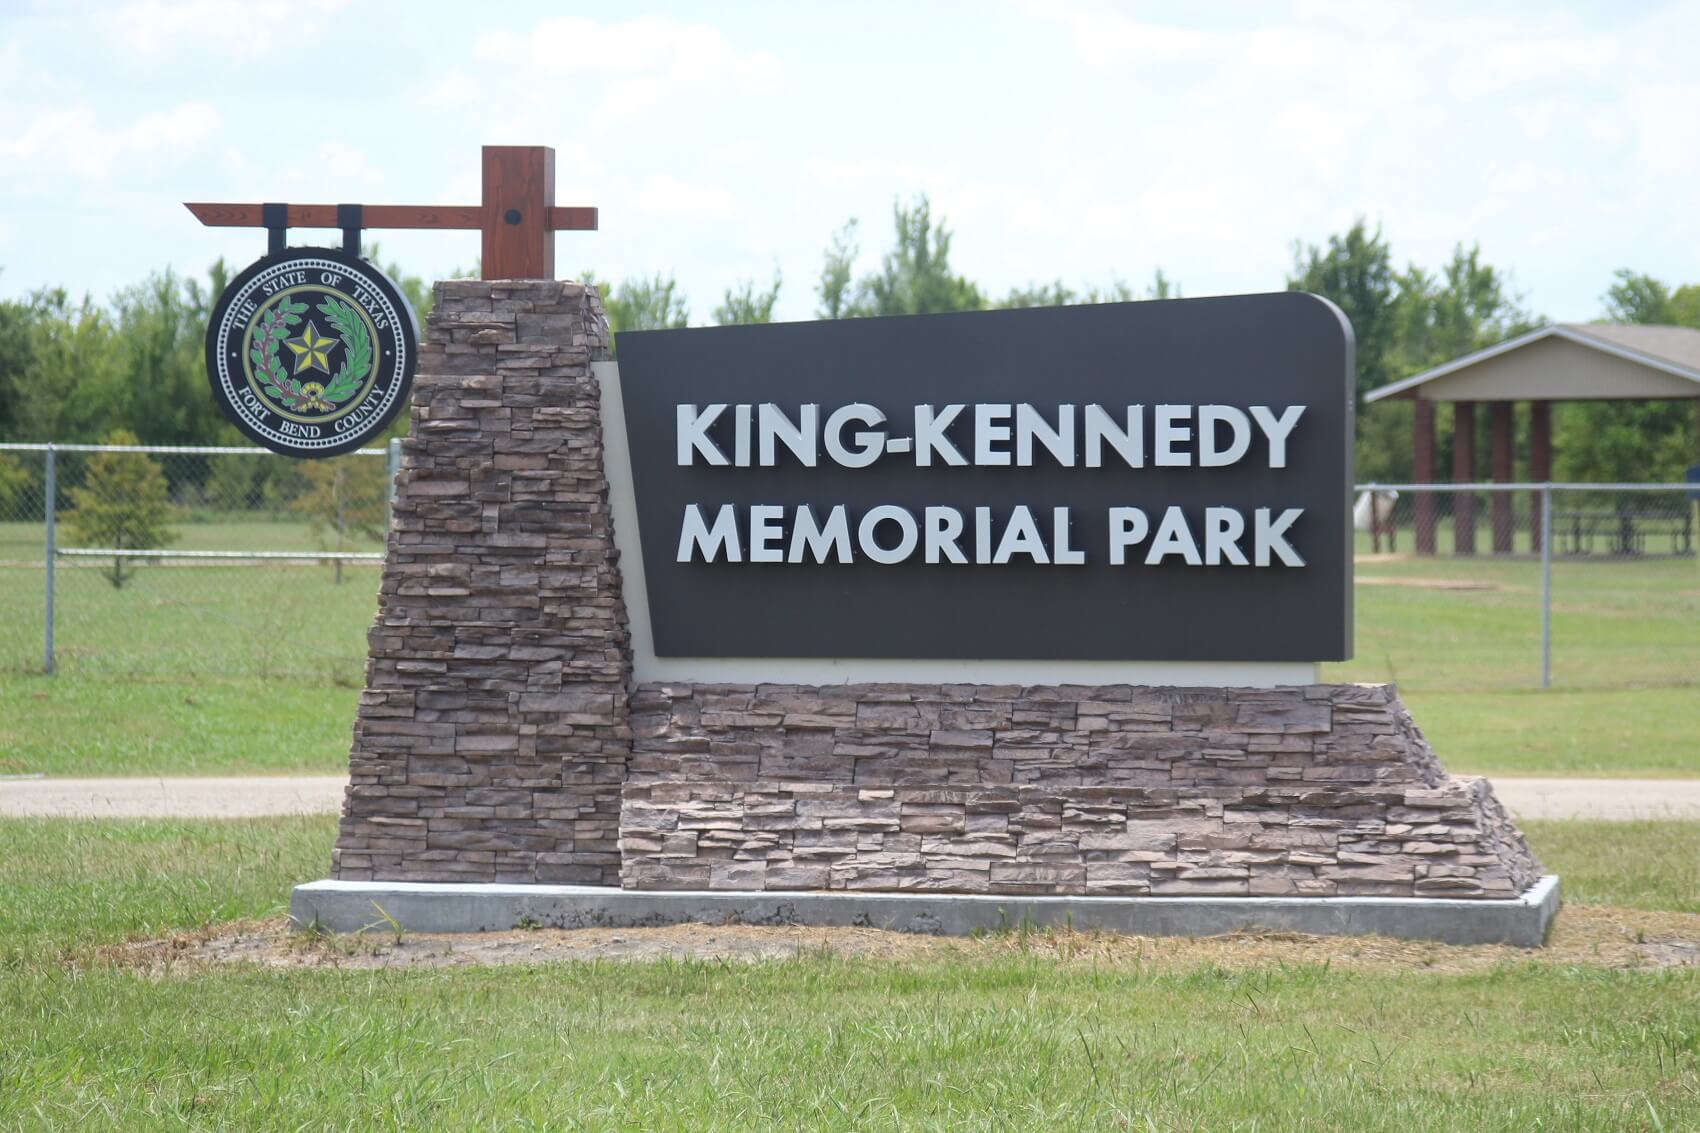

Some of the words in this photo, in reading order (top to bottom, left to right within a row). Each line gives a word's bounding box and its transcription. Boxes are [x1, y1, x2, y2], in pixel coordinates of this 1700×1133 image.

[233, 298, 258, 331] THE
[262, 270, 307, 296] STATE
[320, 271, 343, 289] OF
[352, 285, 390, 331] TEXAS
[238, 385, 271, 421] FORT
[279, 421, 321, 439] BEND
[334, 385, 386, 433] COUNTY
[676, 402, 1307, 468] KING-KENNEDY
[676, 503, 1085, 565] MEMORIAL
[1108, 506, 1305, 567] PARK
